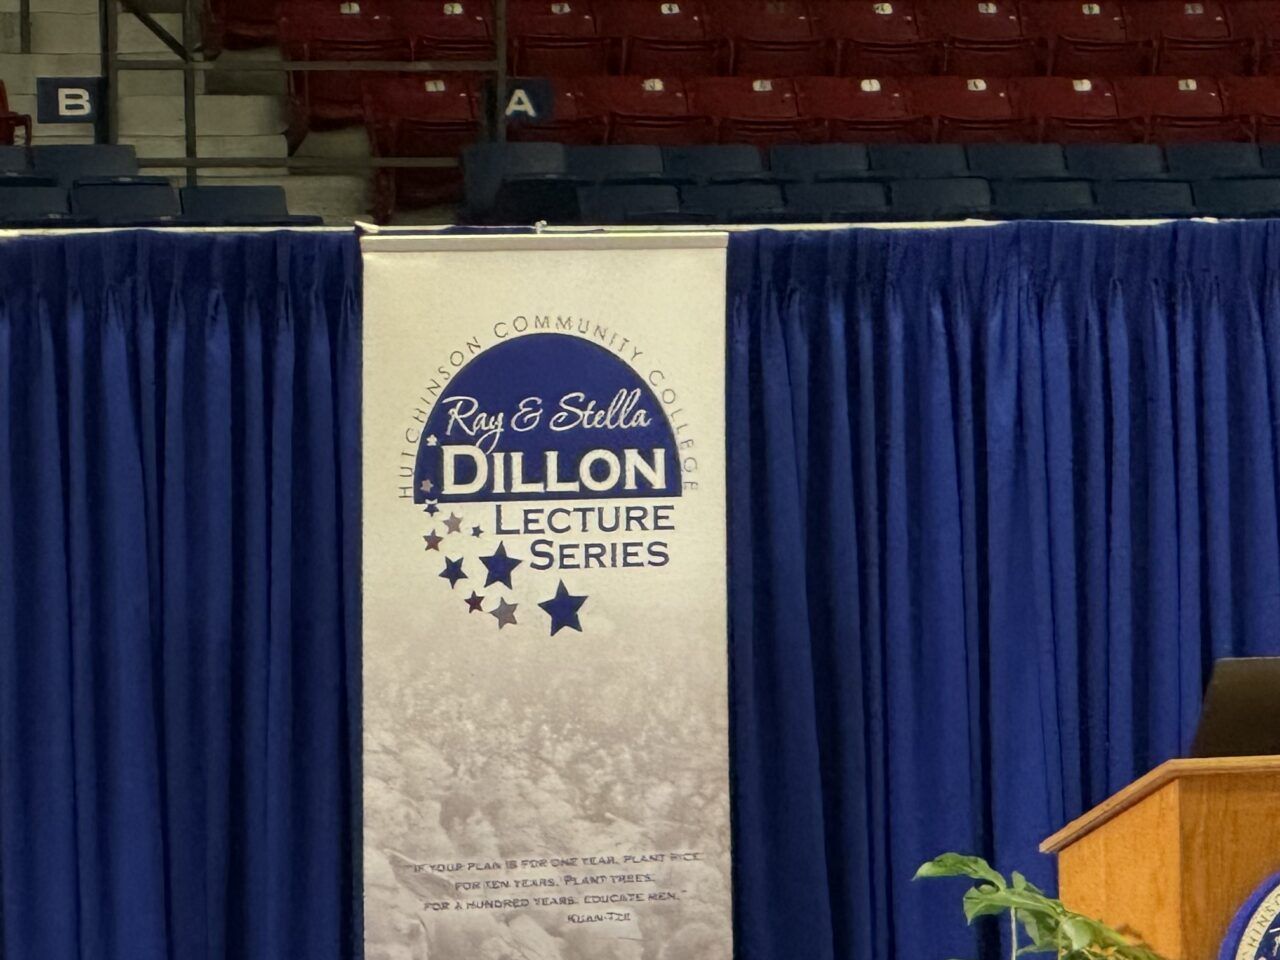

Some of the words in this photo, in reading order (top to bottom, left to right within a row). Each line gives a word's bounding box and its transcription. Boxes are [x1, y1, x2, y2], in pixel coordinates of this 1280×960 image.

[57, 87, 91, 116] B
[505, 88, 537, 117] A
[493, 315, 643, 362] COMMUNITY
[648, 369, 699, 491] COLLEGE
[441, 395, 504, 455] Ray
[510, 396, 543, 432] &
[549, 387, 652, 432] Stella
[441, 444, 667, 495] DILLON
[495, 503, 676, 535] LECTURE
[529, 539, 670, 571] SERIES
[467, 861, 501, 872] PLAN
[521, 858, 548, 869] FOR
[624, 853, 666, 864] PLANT
[455, 881, 481, 891] FOR
[485, 879, 510, 890] TEN
[564, 874, 607, 886] PLANT
[424, 901, 450, 912] FOR
[466, 898, 530, 910] HUNDRED
[584, 893, 645, 905] EDUCATE
